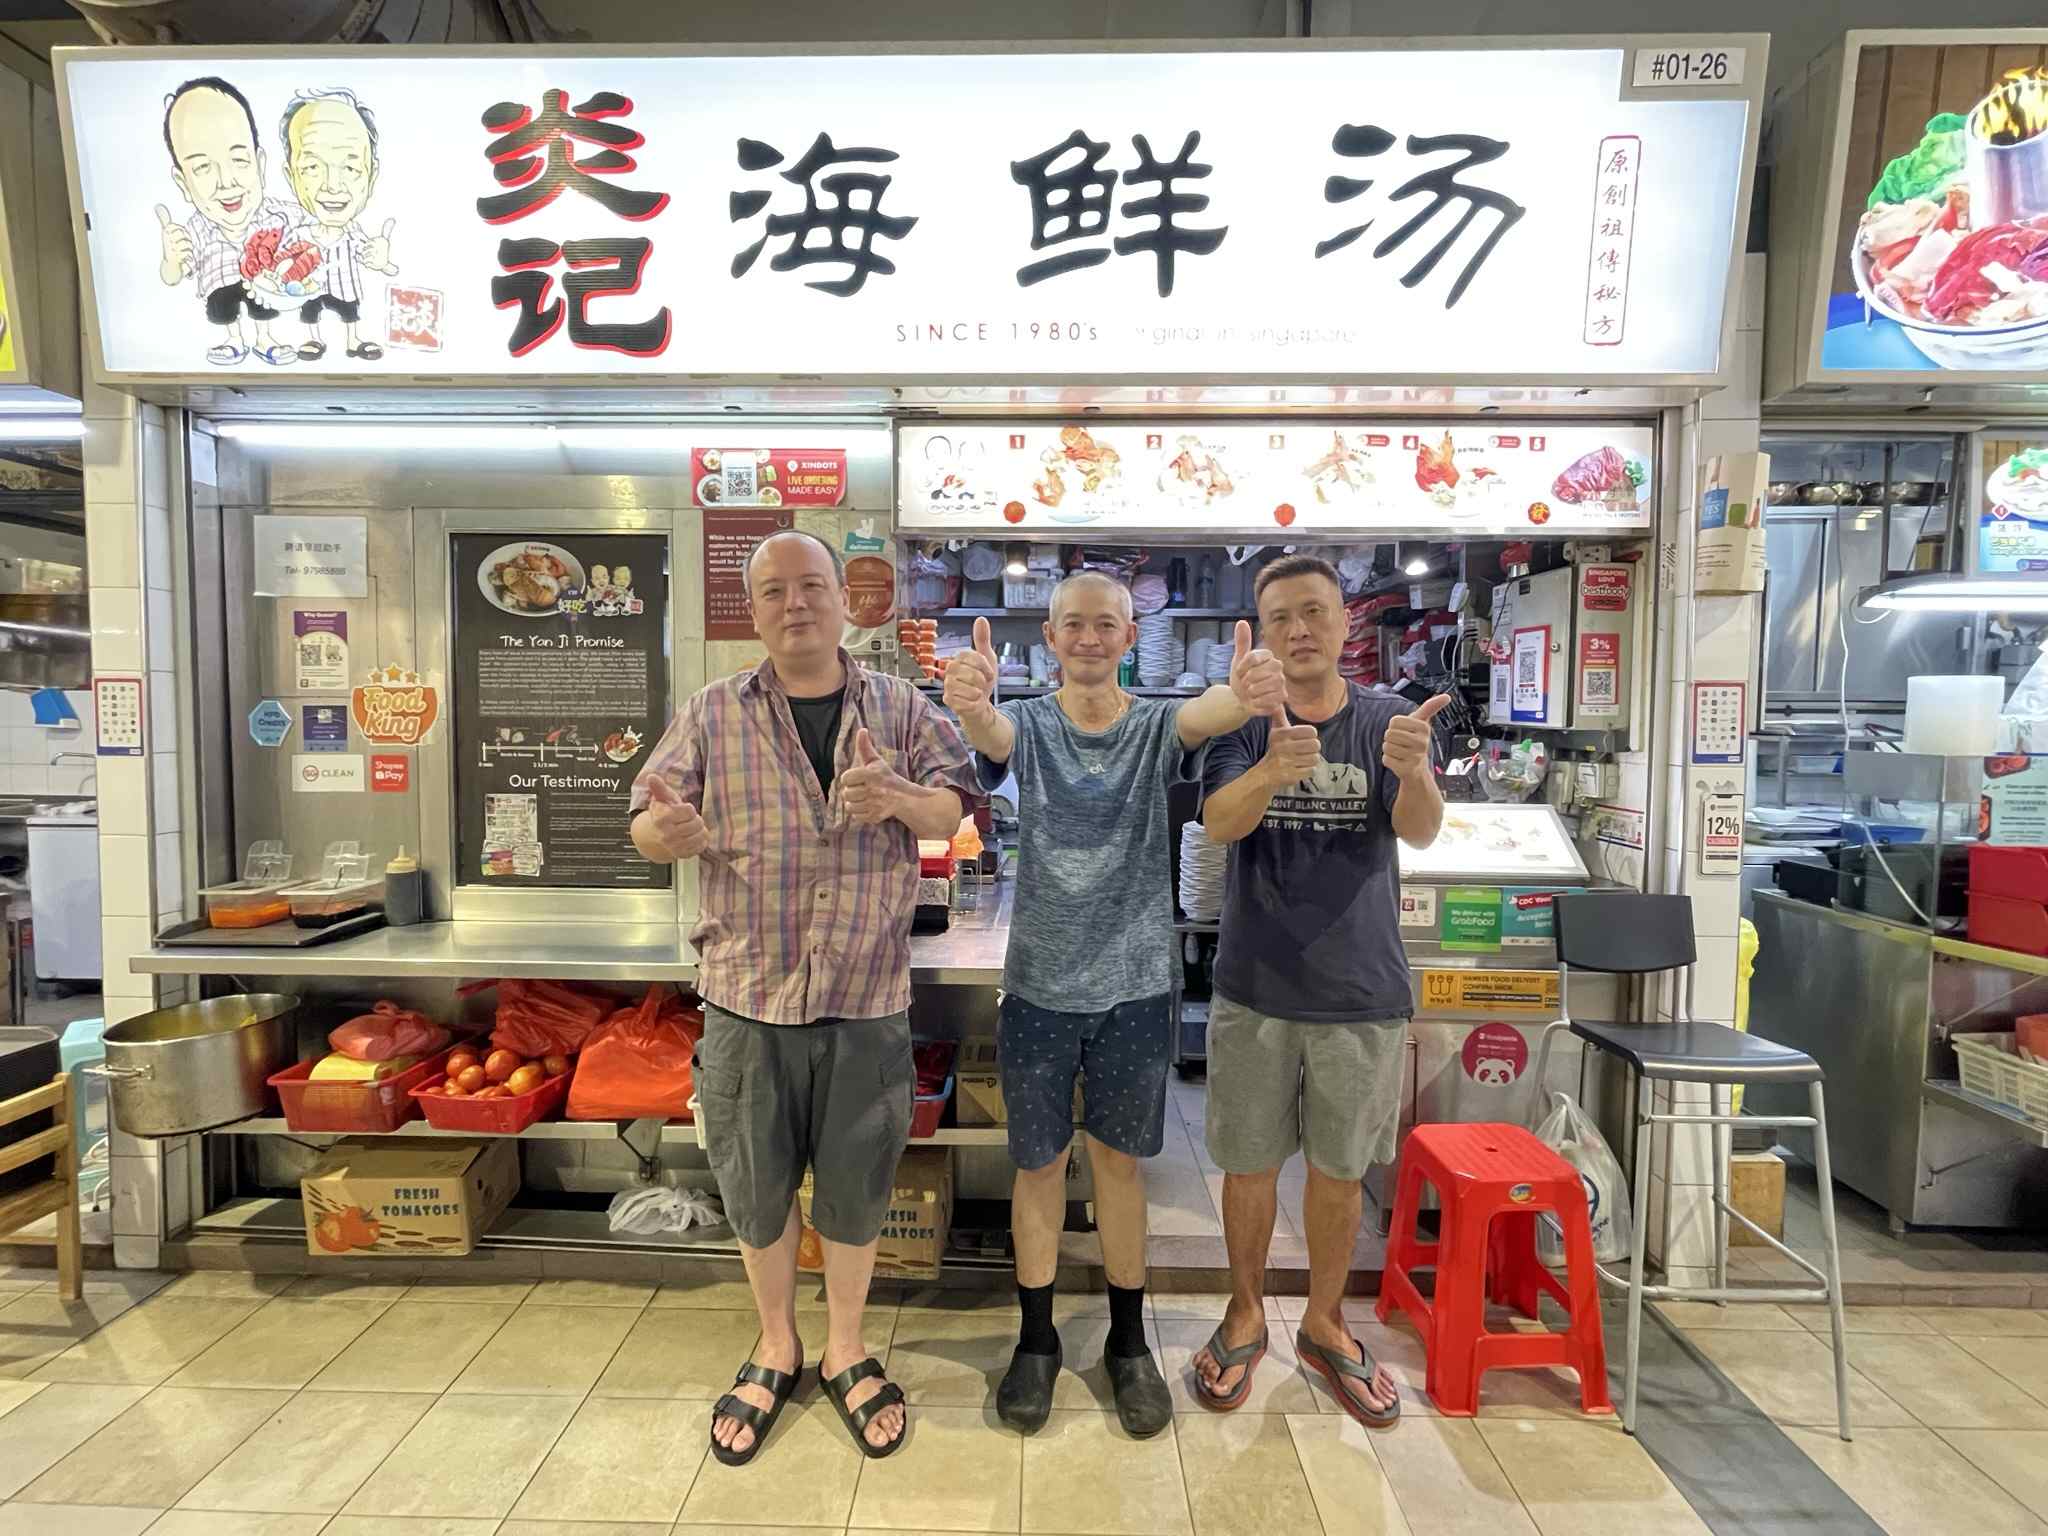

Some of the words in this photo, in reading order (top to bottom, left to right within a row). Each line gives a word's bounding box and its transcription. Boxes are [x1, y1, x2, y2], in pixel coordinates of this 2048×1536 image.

[1651, 53, 1728, 80] #01-26
[476, 88, 671, 358] 炎记
[729, 123, 1526, 310] 海鲜汤
[896, 322, 989, 343] SINCE
[1010, 321, 1098, 343] 1980's
[787, 486, 813, 495] MADE
[814, 486, 838, 495] EASY
[499, 635, 524, 648] The
[529, 635, 553, 648] Yan
[558, 634, 569, 649] Ji
[575, 635, 624, 648] Promise
[1590, 638, 1611, 650] 3%
[364, 687, 427, 712] Food
[364, 711, 420, 741] King
[321, 769, 354, 777] CLEAN
[385, 771, 404, 782] Pay
[509, 774, 537, 788] Our
[540, 774, 620, 791] Testimony
[1330, 801, 1367, 811] VALLEY
[1707, 816, 1740, 835] 12%
[1451, 917, 1495, 926] GrabFood
[394, 1188, 439, 1199] FRESH
[383, 1204, 458, 1216] TOMATOES
[885, 1209, 917, 1222] ESH
[880, 1226, 934, 1239] MATOES
